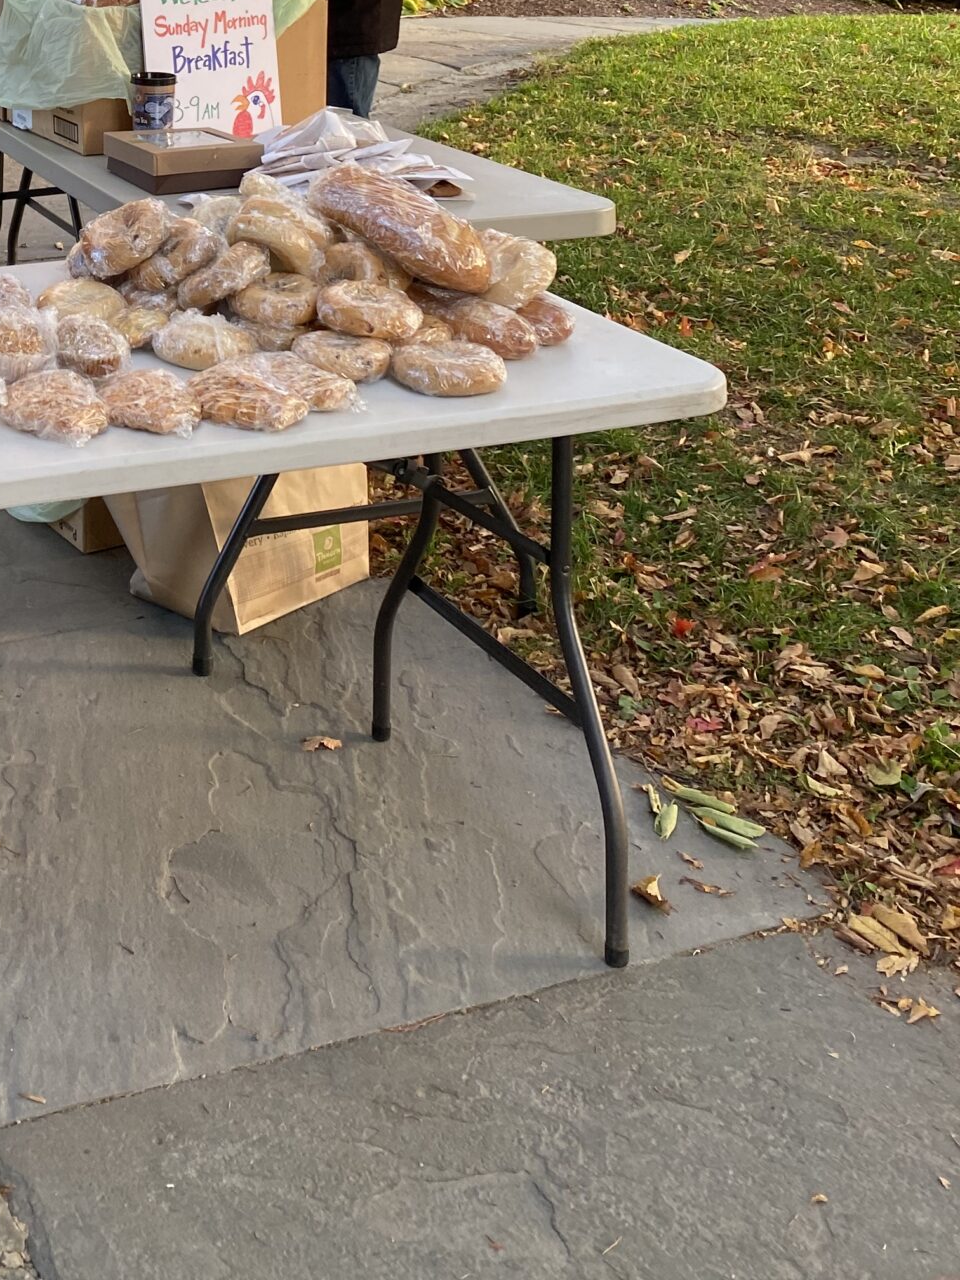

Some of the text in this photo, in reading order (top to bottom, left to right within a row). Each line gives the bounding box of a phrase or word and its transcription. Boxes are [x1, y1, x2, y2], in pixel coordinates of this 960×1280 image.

[154, 10, 268, 49] Sunday Morning
[172, 36, 253, 74] Breakfast
[201, 102, 220, 120] AM
